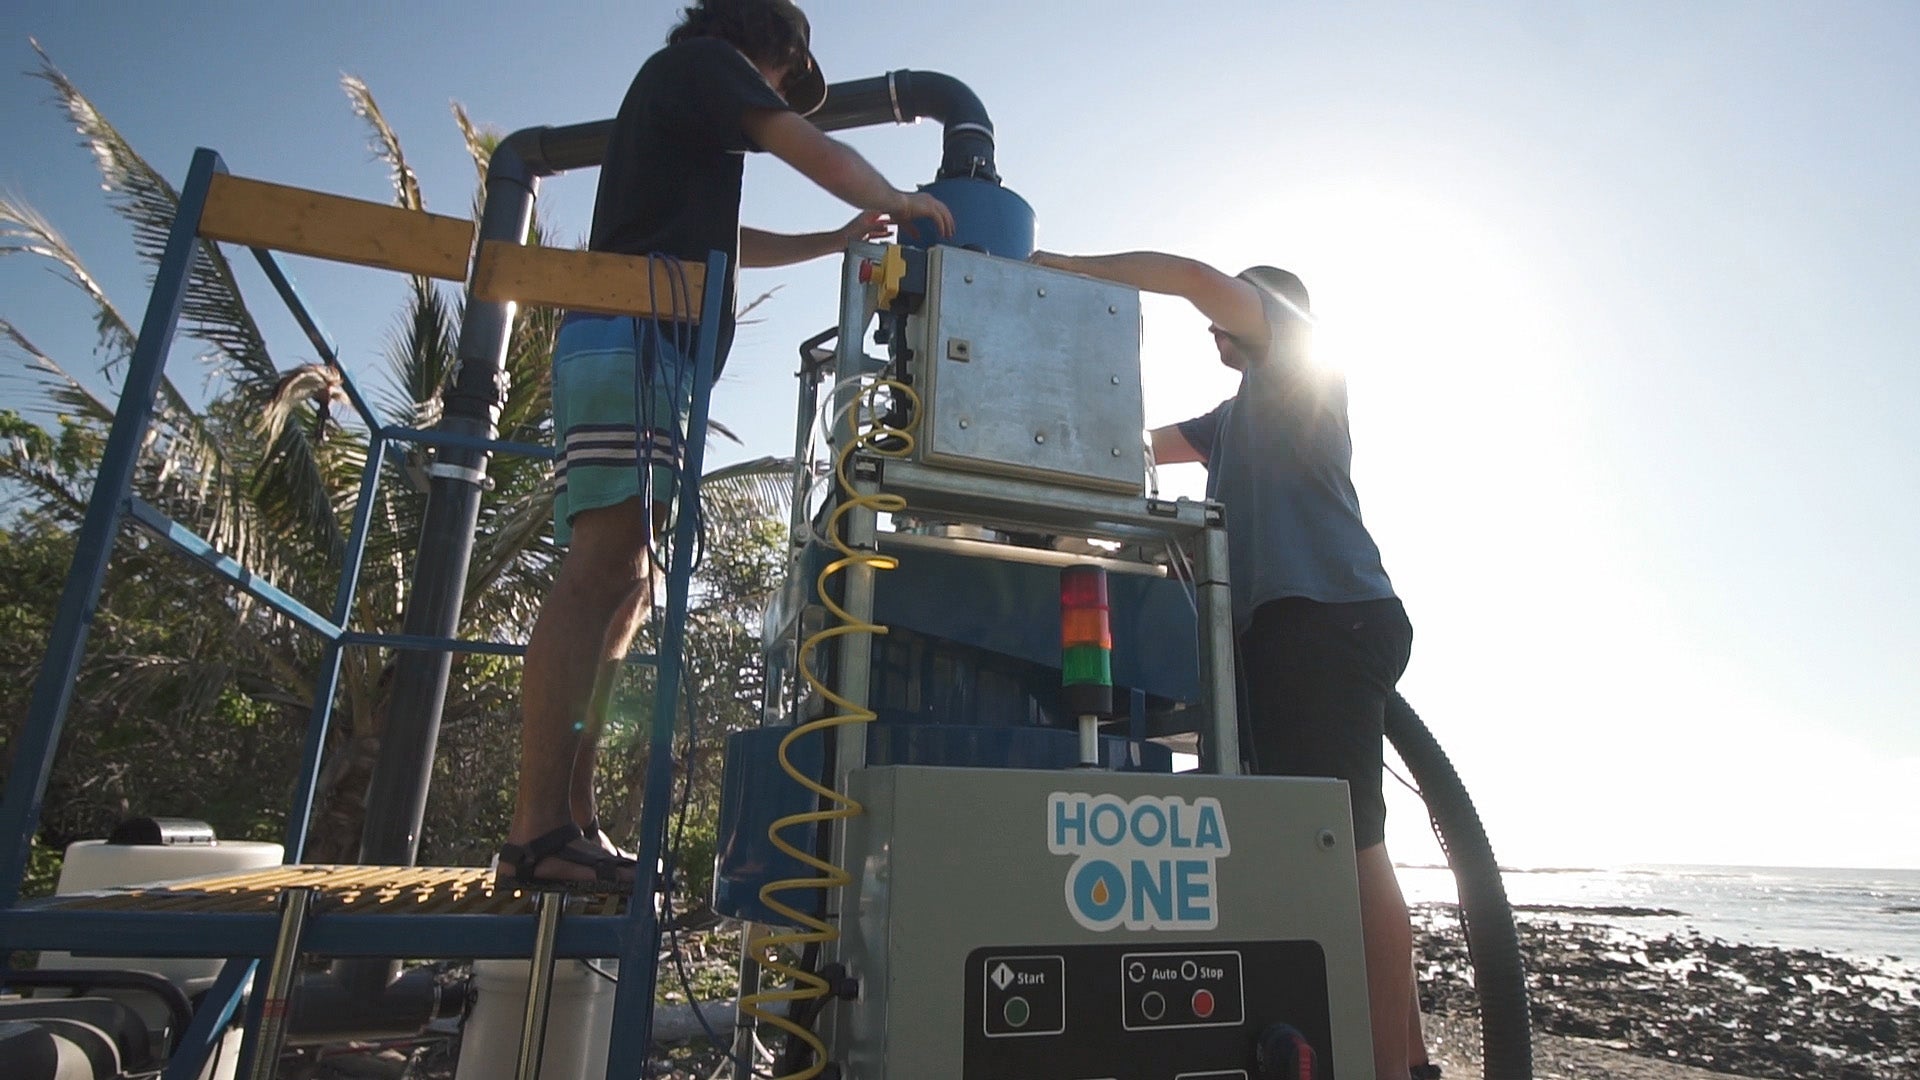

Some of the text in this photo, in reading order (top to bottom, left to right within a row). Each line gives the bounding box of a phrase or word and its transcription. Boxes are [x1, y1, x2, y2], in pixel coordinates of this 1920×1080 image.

[1055, 801, 1223, 848] HOOLA
[1073, 860, 1211, 922] ONE
[1017, 971, 1045, 985] Start
[1152, 965, 1224, 981] Auto Stop
